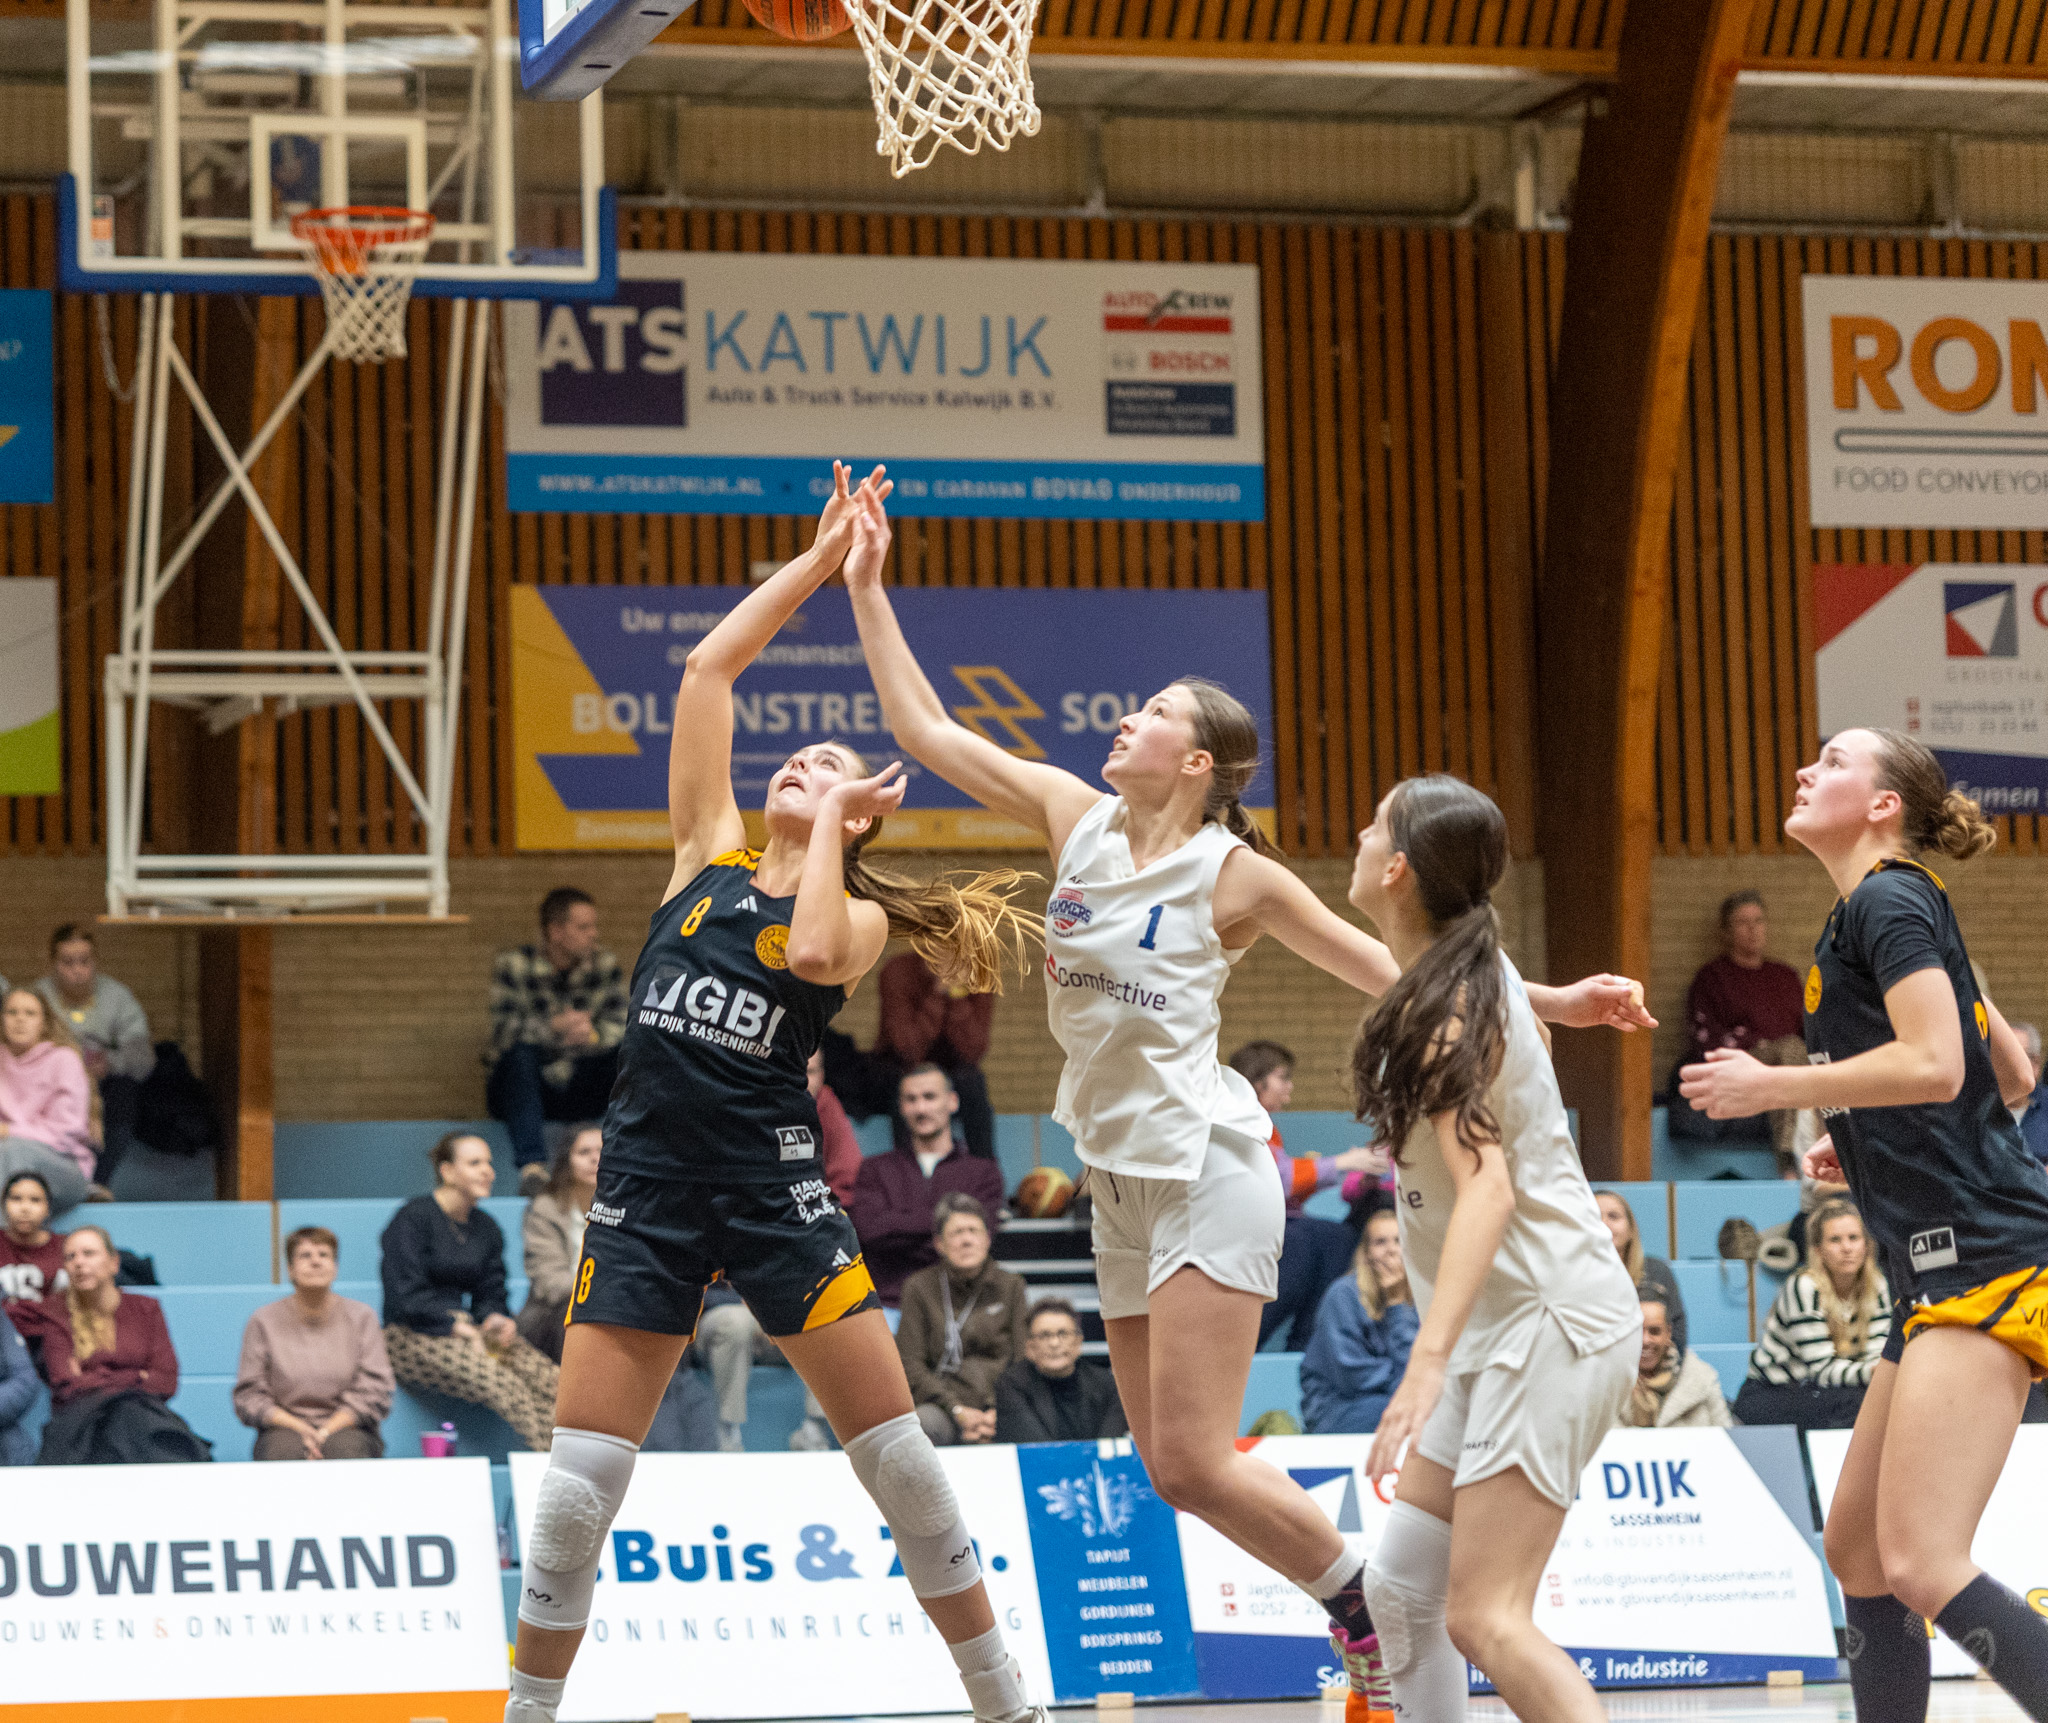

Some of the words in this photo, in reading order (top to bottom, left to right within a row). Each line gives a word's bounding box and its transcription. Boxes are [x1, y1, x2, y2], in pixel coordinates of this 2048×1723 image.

[538, 306, 687, 373] ATS
[704, 309, 1053, 378] KATWIJK
[1149, 352, 1231, 372] BOSCH
[706, 385, 756, 405] Auto
[784, 386, 843, 406] Truck
[850, 388, 929, 407] Service
[935, 389, 1013, 411] Katwijk
[1833, 466, 1908, 493] FOOD
[680, 896, 713, 938] 8
[1137, 903, 1165, 952] 1
[1058, 967, 1168, 1012] Comfective
[684, 975, 787, 1048] GBI
[638, 1009, 659, 1027] VAN
[658, 1013, 687, 1034] DIJK
[688, 1021, 774, 1060] SASSENHEIM
[1602, 1459, 1697, 1507] DIJK
[1609, 1512, 1703, 1528] SASSENHEIM
[795, 1522, 864, 1584] &
[1604, 1534, 1707, 1548] INDUSTRIE
[1085, 1548, 1131, 1564] TAPIJT
[1077, 1575, 1149, 1593] MEUBELEN
[154, 1615, 170, 1640] &
[186, 1609, 463, 1638] ONTWIKKELEN
[1080, 1603, 1155, 1621] GORDIJNEN
[1080, 1630, 1163, 1649] BOXSPRINGS
[1100, 1659, 1153, 1676] BEDDEN
[1605, 1654, 1710, 1682] Industrie
